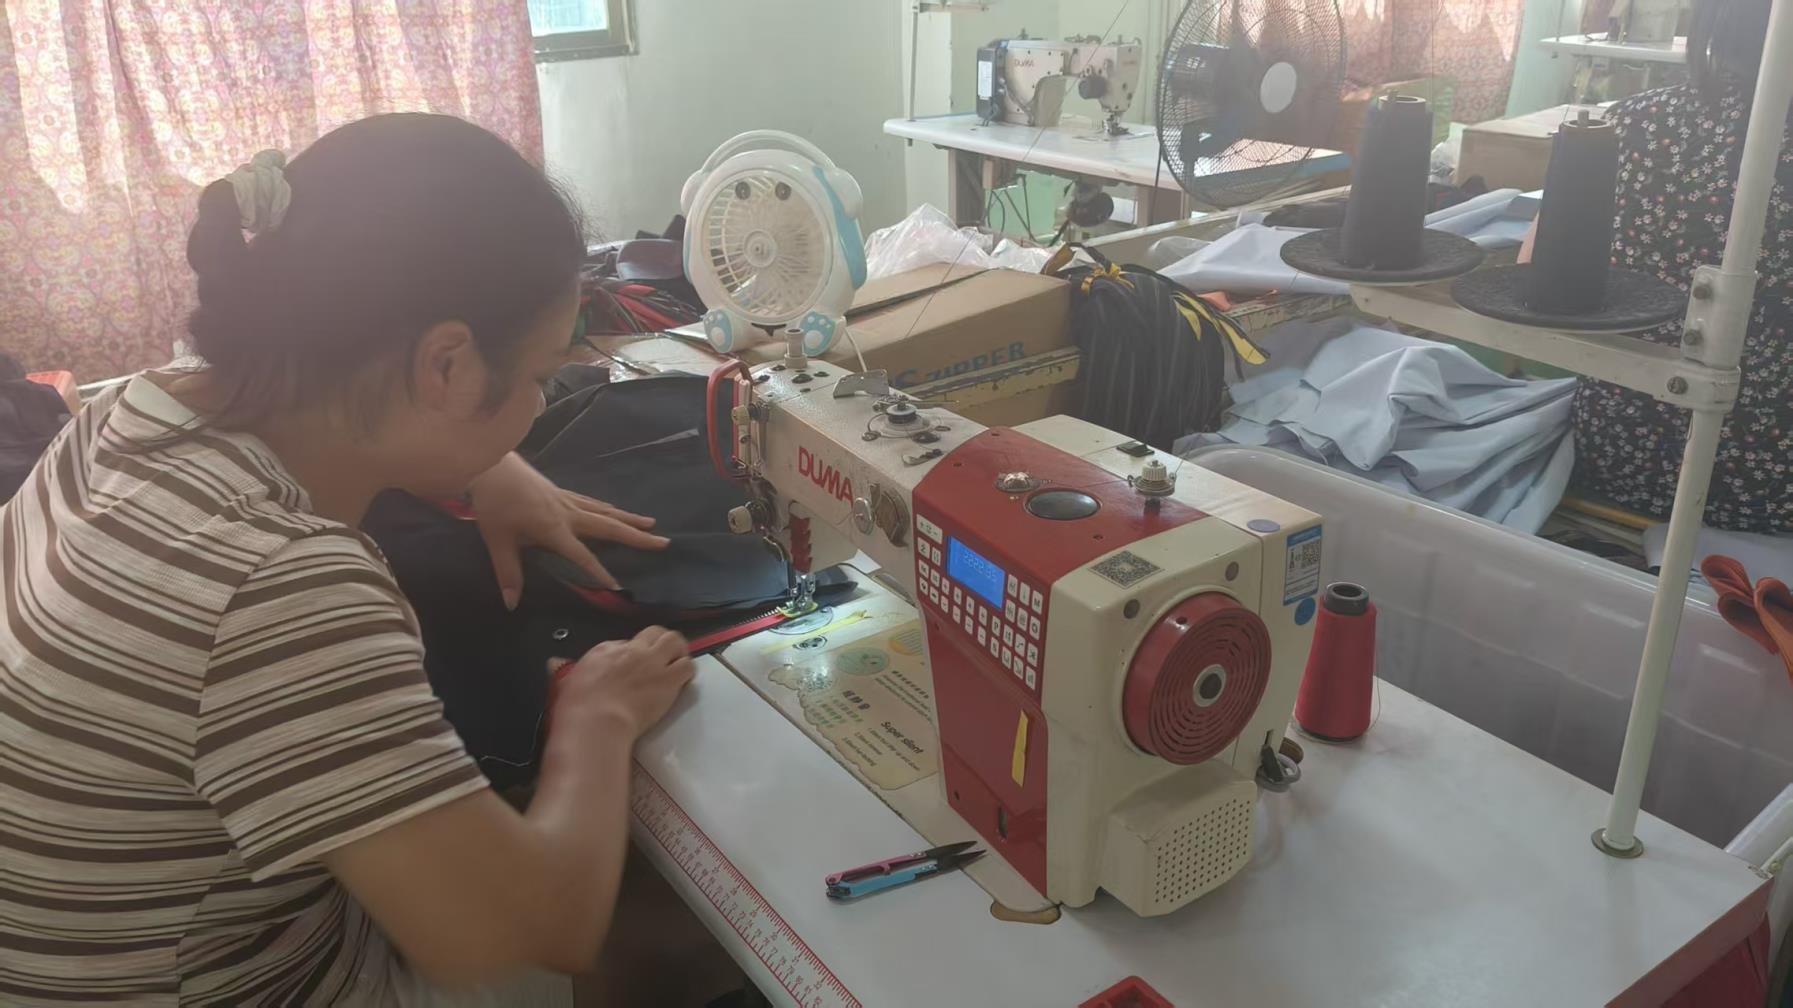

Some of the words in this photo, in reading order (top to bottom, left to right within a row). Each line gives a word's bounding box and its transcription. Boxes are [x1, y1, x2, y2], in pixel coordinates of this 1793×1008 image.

[798, 445, 854, 508] DUMA
[880, 721, 904, 738] Super
[901, 738, 924, 754] silent
